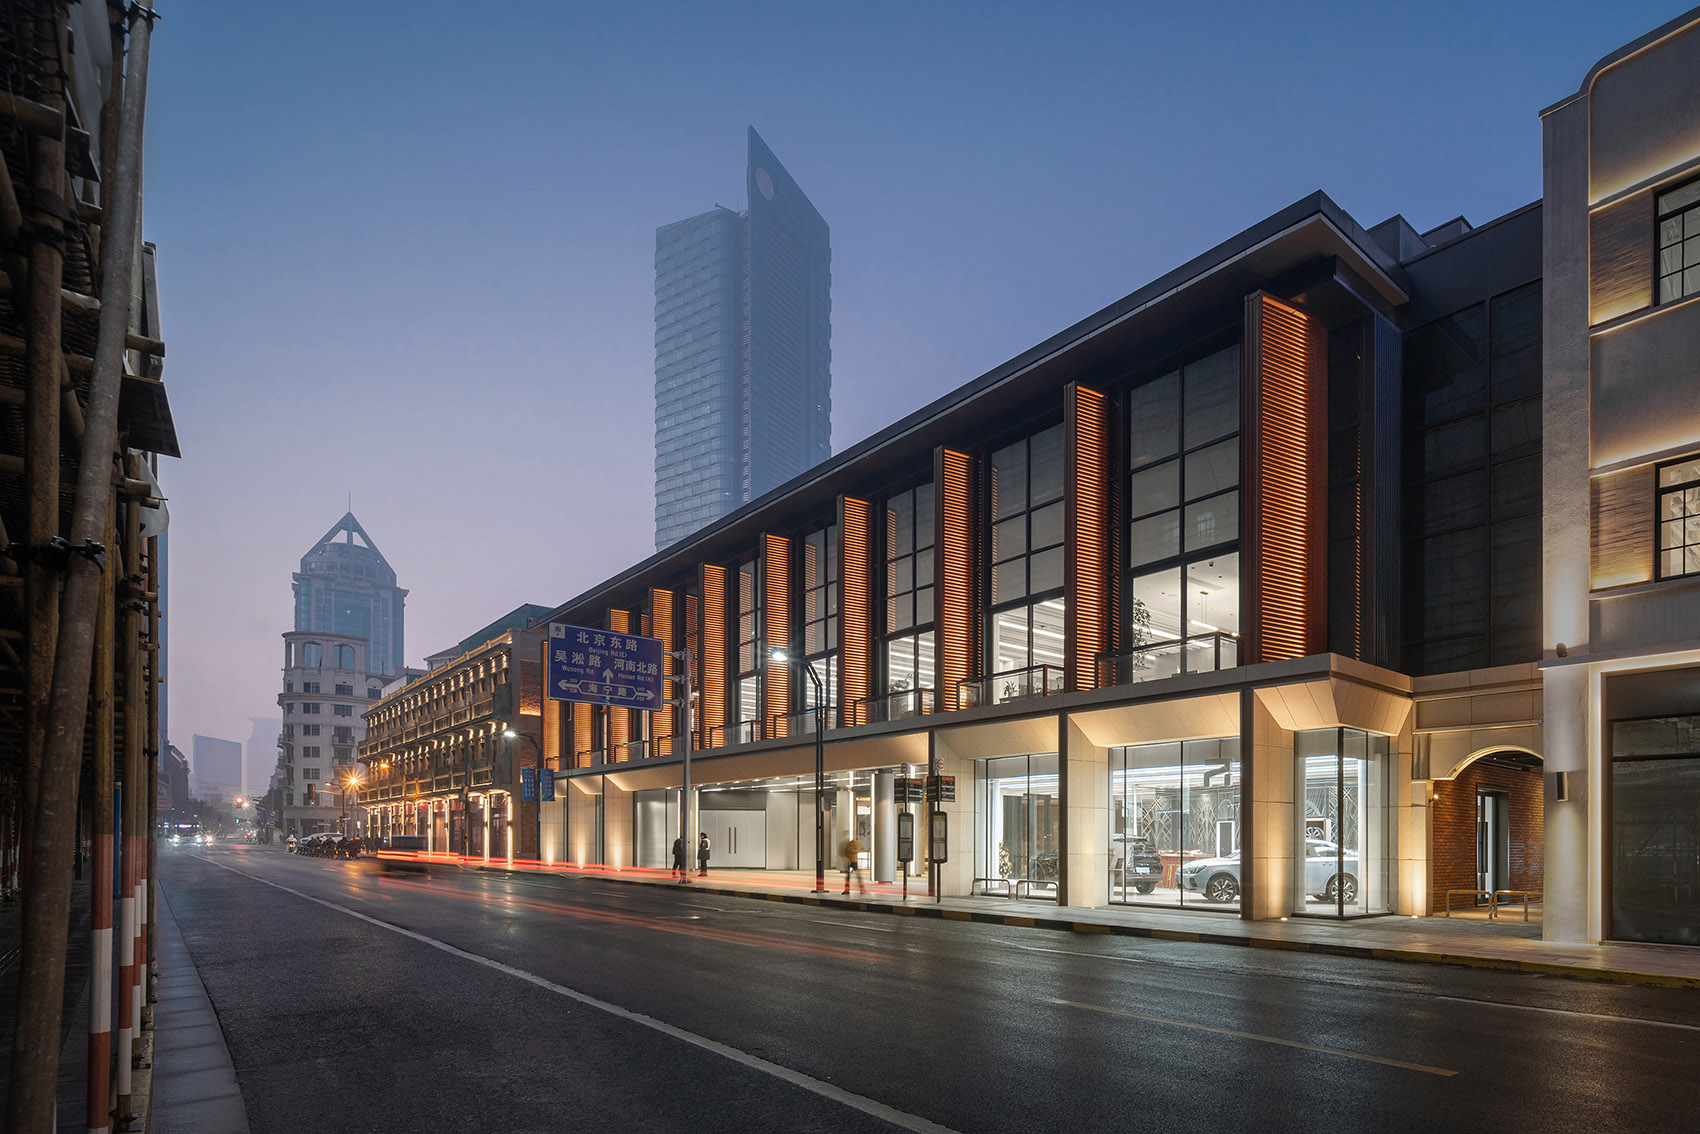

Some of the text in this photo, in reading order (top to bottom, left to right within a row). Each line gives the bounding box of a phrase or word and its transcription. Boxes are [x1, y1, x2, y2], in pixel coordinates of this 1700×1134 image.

[577, 631, 638, 652] 北京东路
[588, 647, 609, 656] Beijing
[554, 649, 602, 668] 吴淞路
[562, 665, 584, 675] Wusong
[614, 658, 658, 676] 河南北路
[618, 673, 636, 681] Henan
[588, 684, 627, 697] 海宁路
